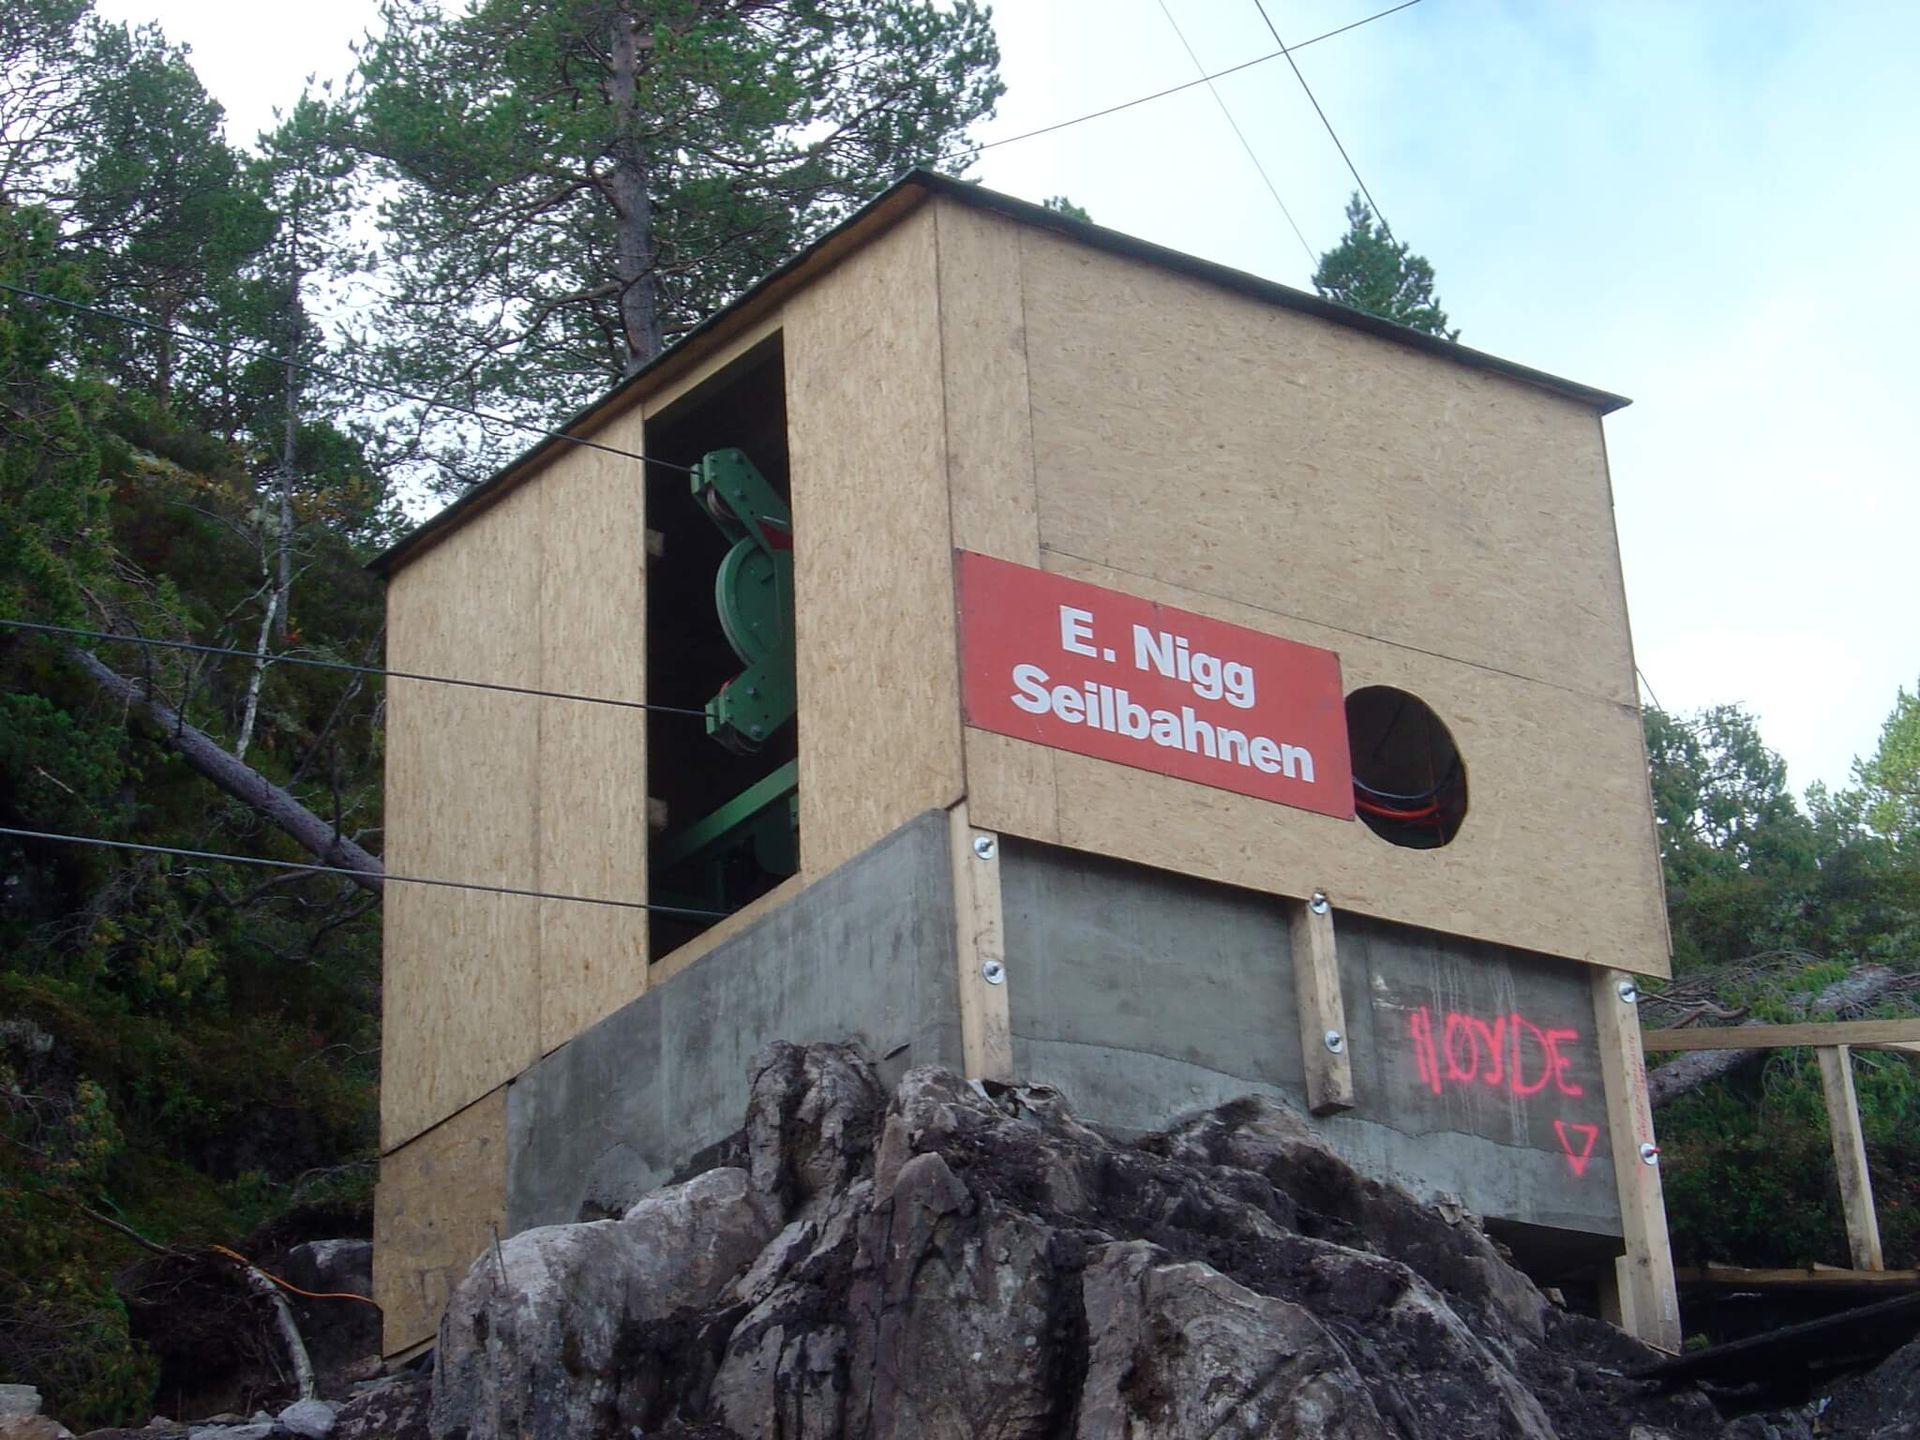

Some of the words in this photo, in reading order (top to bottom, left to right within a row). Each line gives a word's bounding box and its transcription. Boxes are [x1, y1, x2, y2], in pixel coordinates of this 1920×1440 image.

[1059, 604, 1116, 663] E.
[1132, 624, 1255, 709] Nigg
[1010, 663, 1315, 783] Seilbahnen
